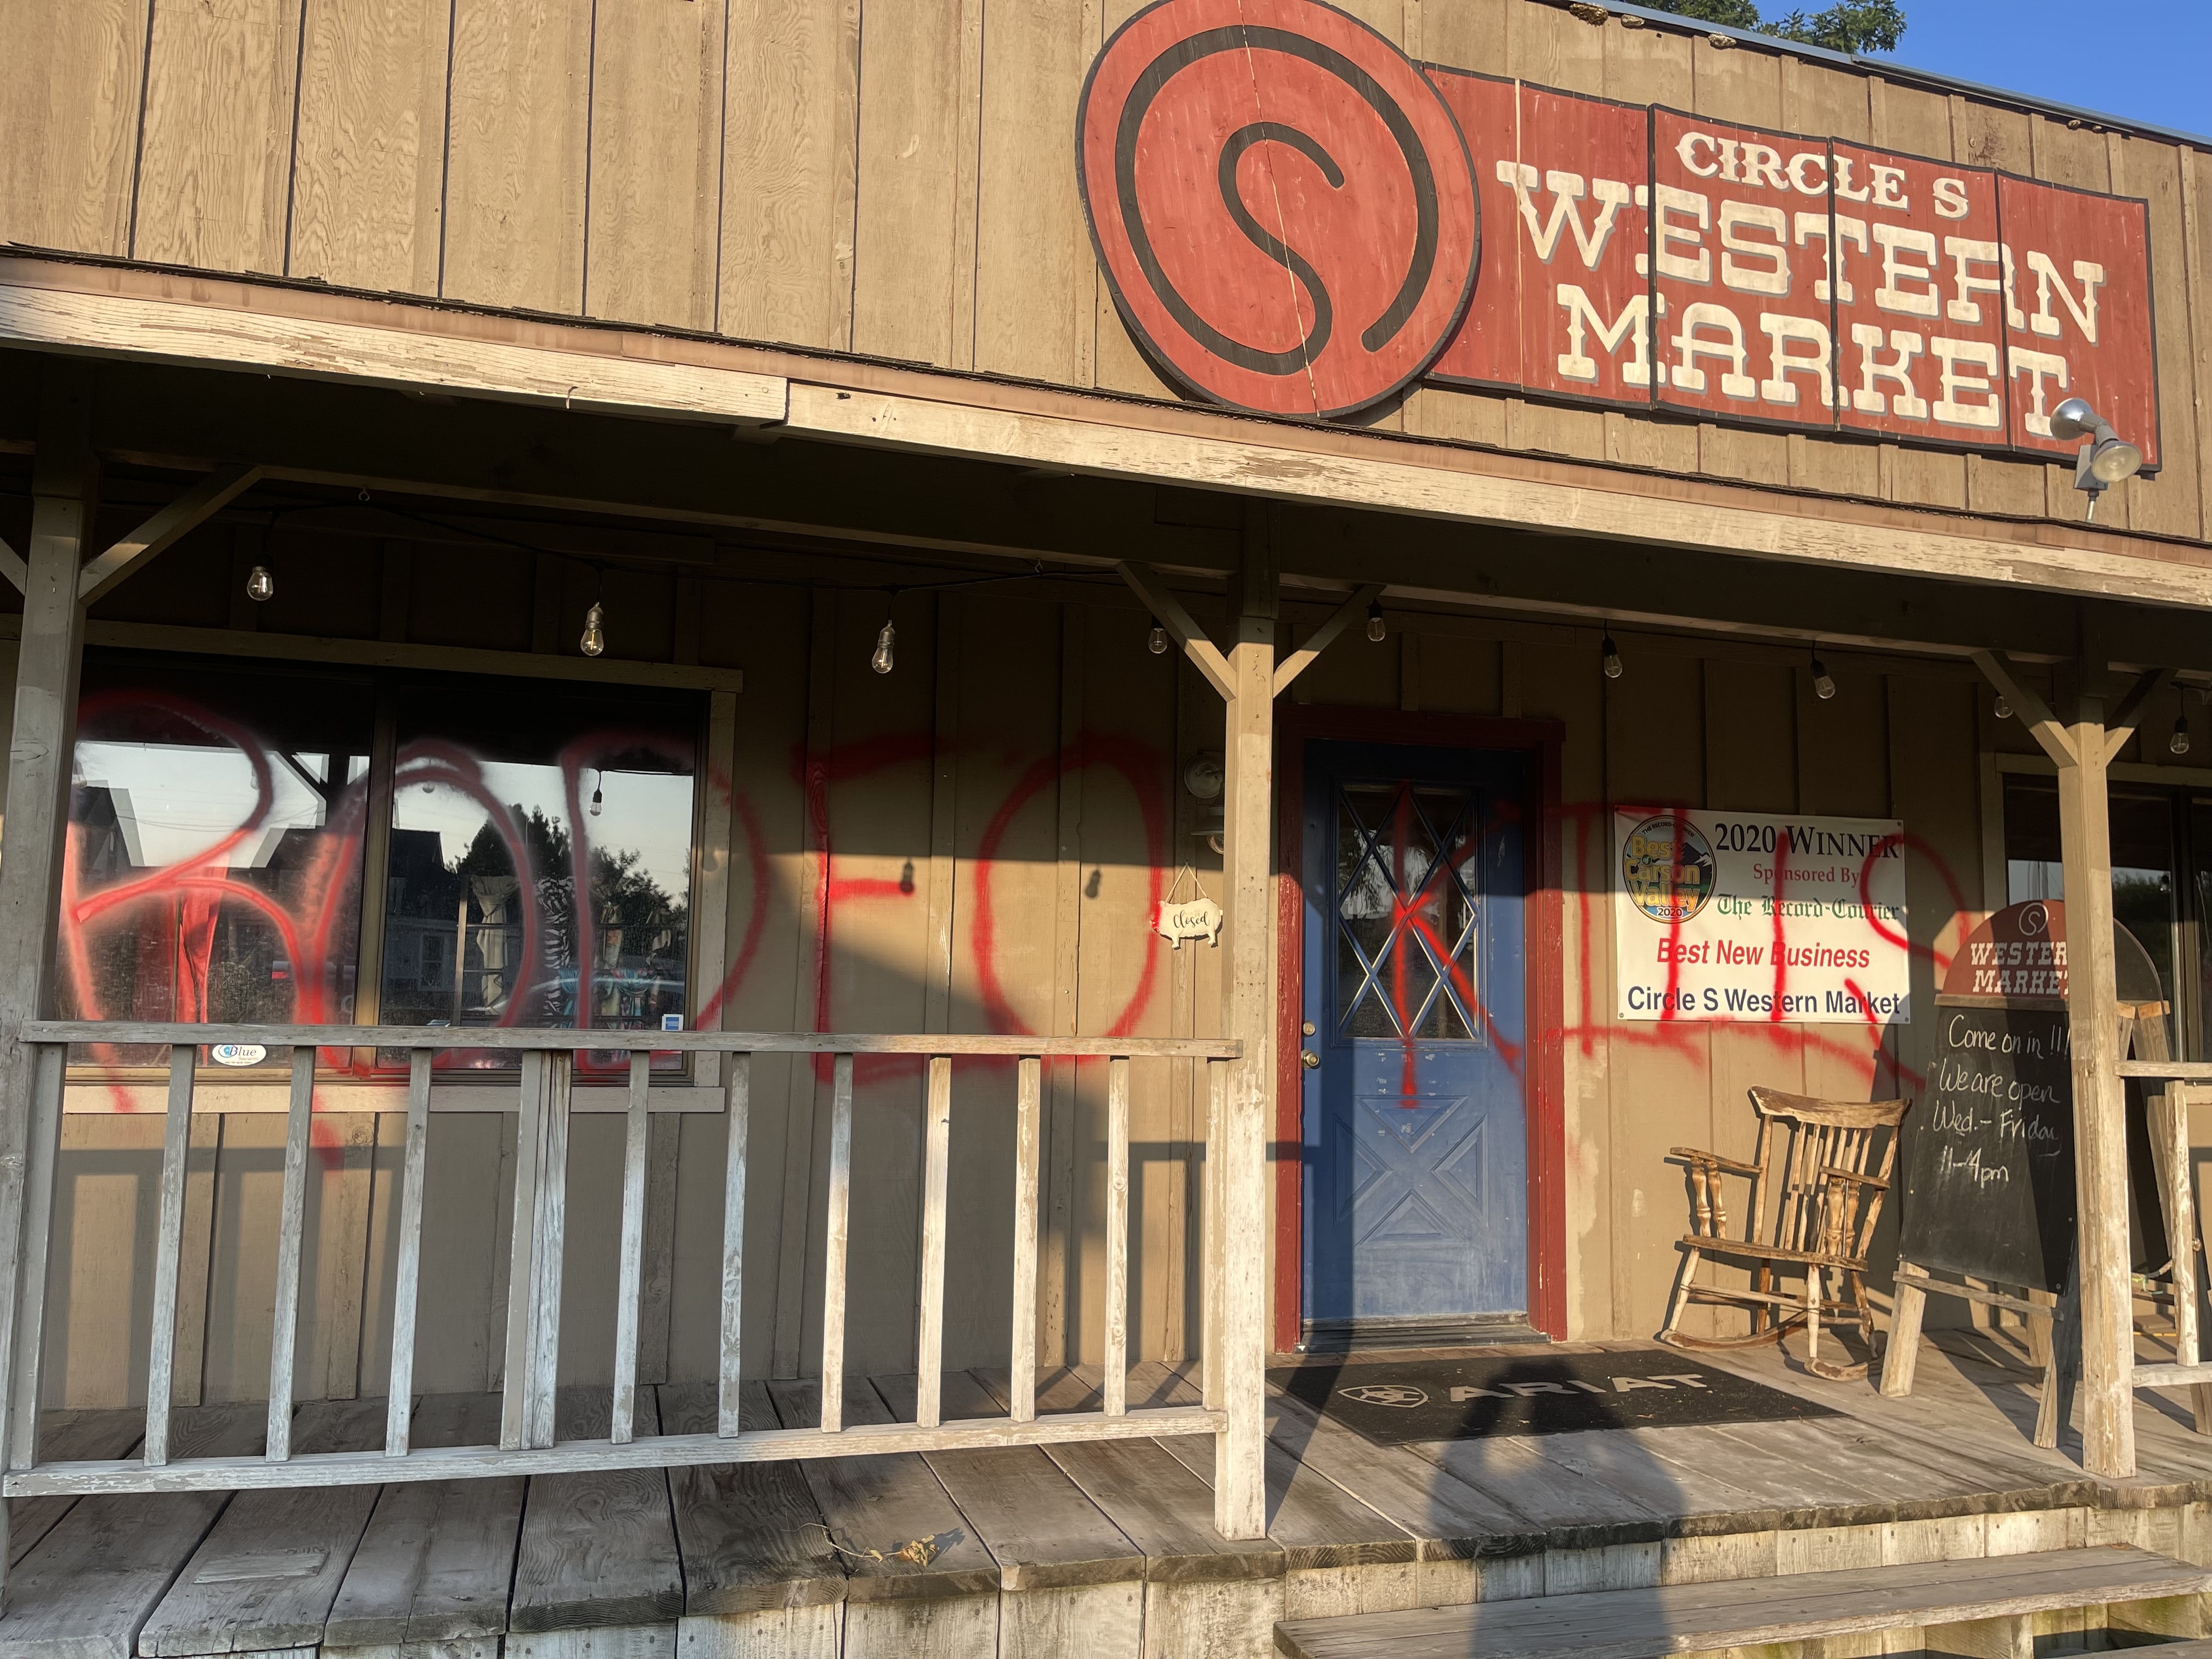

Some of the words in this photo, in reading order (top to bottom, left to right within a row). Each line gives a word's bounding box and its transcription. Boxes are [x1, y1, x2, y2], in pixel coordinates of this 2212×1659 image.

[1675, 132, 1908, 209] CIRCLE
[1932, 178, 1969, 218] S
[1496, 160, 2103, 343] WESTERN
[1556, 283, 2067, 437] MARKET
[1642, 826, 1652, 834] THE
[1715, 823, 1776, 853] 2020
[1631, 836, 1683, 859] Best
[1626, 859, 1700, 884] Carson
[1841, 867, 1860, 888] By
[1632, 882, 1700, 912] Valley
[1718, 894, 1752, 920] The
[1174, 910, 1209, 928] Closed
[1658, 908, 1682, 916] 2020
[1657, 938, 1710, 964] Best
[1716, 940, 1763, 965] New
[1770, 941, 1870, 968] Business
[1971, 941, 2067, 966] WESTER
[1628, 986, 1695, 1012] Circle
[1703, 988, 1718, 1012] S
[1724, 989, 1817, 1013] Western
[1826, 991, 1900, 1014] Market
[1949, 1014, 1997, 1051] Come
[2001, 1032, 2021, 1054] on
[2027, 1030, 2044, 1059] in
[229, 1046, 256, 1056] Blue
[1939, 1057, 1968, 1092] We
[1971, 1072, 2003, 1097] are
[2008, 1080, 2061, 1110] open
[1450, 1373, 1707, 1402] ARIAT
